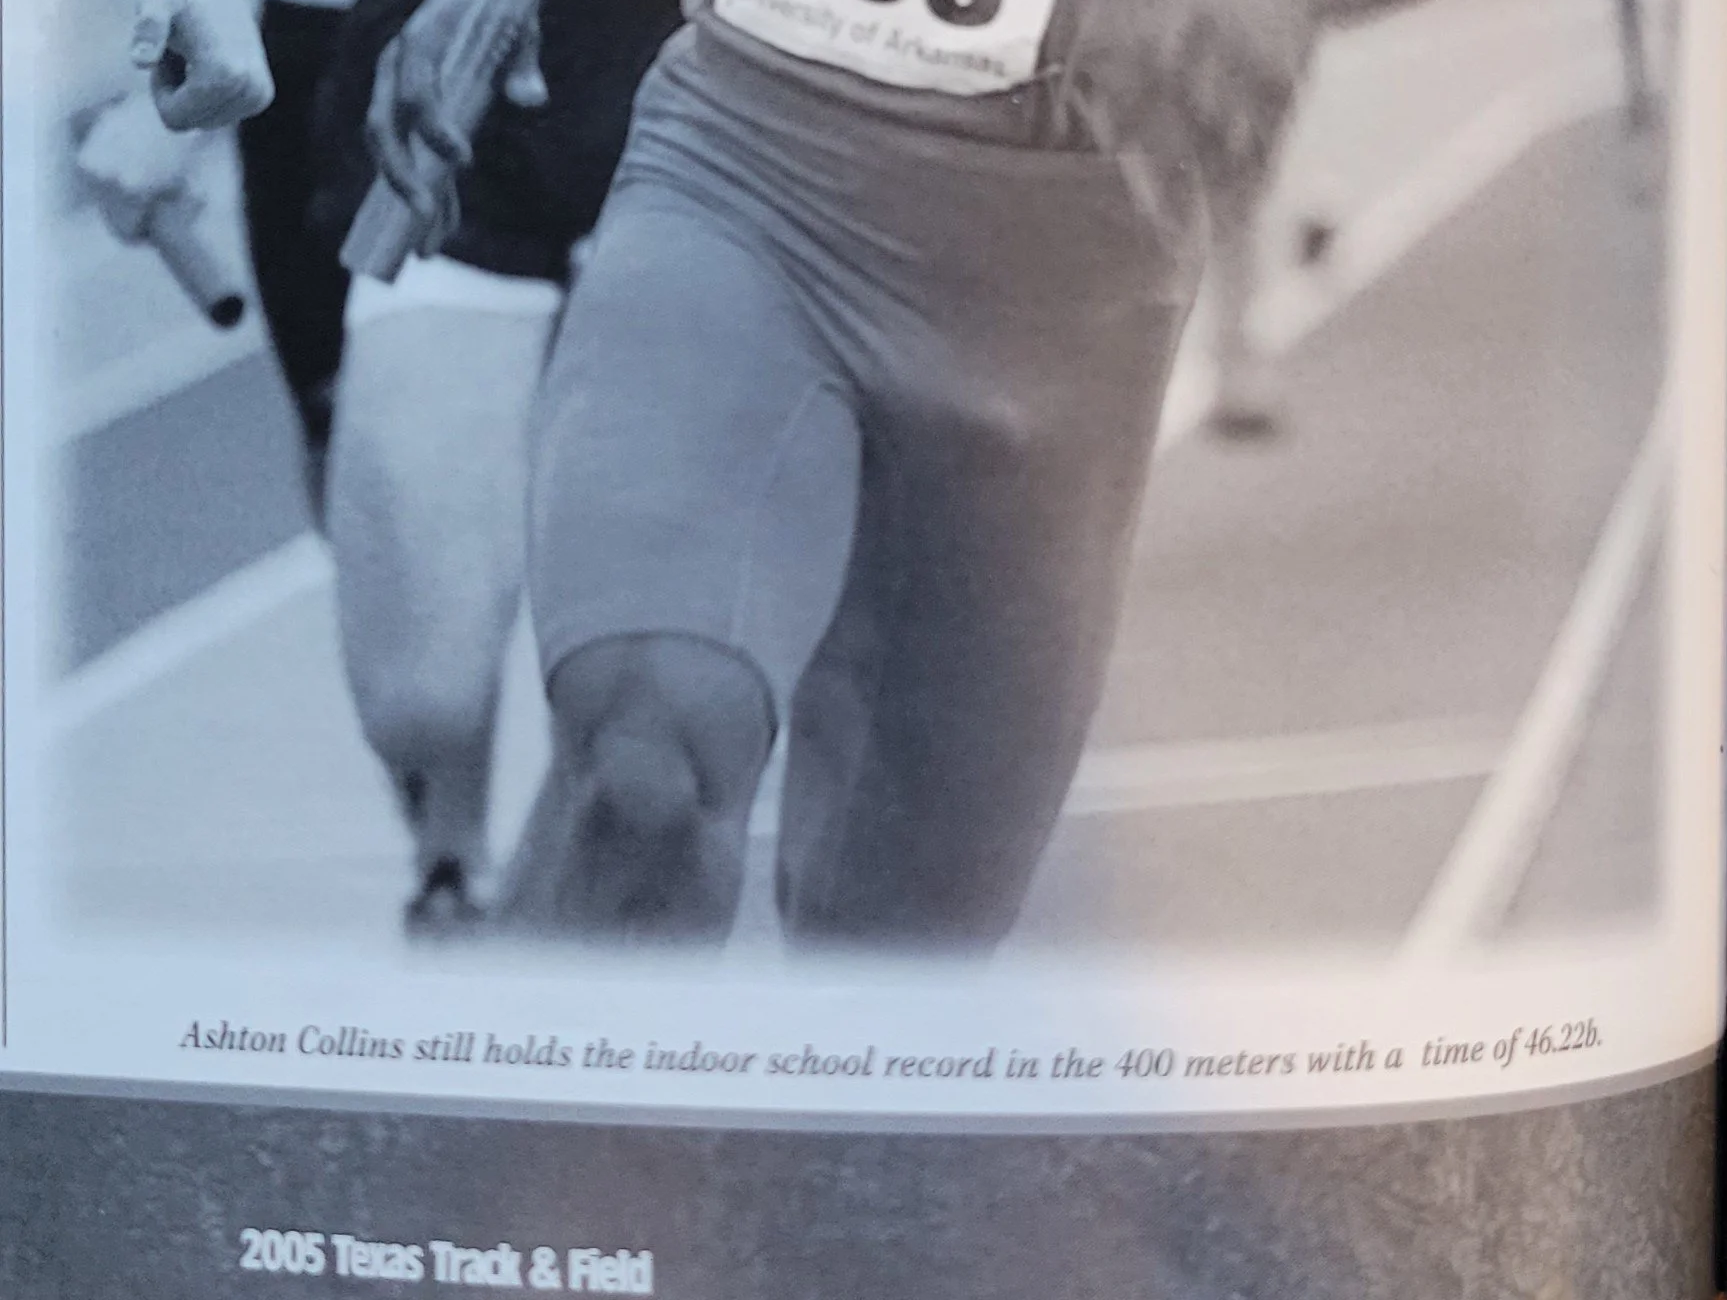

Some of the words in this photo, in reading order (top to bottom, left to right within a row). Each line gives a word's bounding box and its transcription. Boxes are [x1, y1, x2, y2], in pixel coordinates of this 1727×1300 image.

[180, 1019, 288, 1053] Ashton
[297, 1024, 405, 1059] Collins
[413, 1031, 475, 1062] still
[483, 1033, 573, 1067] holds
[582, 1037, 636, 1069] the
[644, 1041, 758, 1073] indoor
[766, 1044, 875, 1076] school
[882, 1046, 996, 1078] record
[1004, 1048, 1040, 1078] in
[1050, 1047, 1104, 1078] the
[1113, 1047, 1176, 1077] 400
[1183, 1045, 1297, 1077] meters
[1307, 1040, 1376, 1073] with
[1384, 1046, 1403, 1071] a
[1421, 1035, 1484, 1067] time
[1493, 1027, 1523, 1068] of
[238, 1227, 326, 1277] 2005
[331, 1233, 425, 1283] Texas
[430, 1239, 524, 1288] Track
[528, 1245, 563, 1290] &
[567, 1247, 655, 1295] Field
